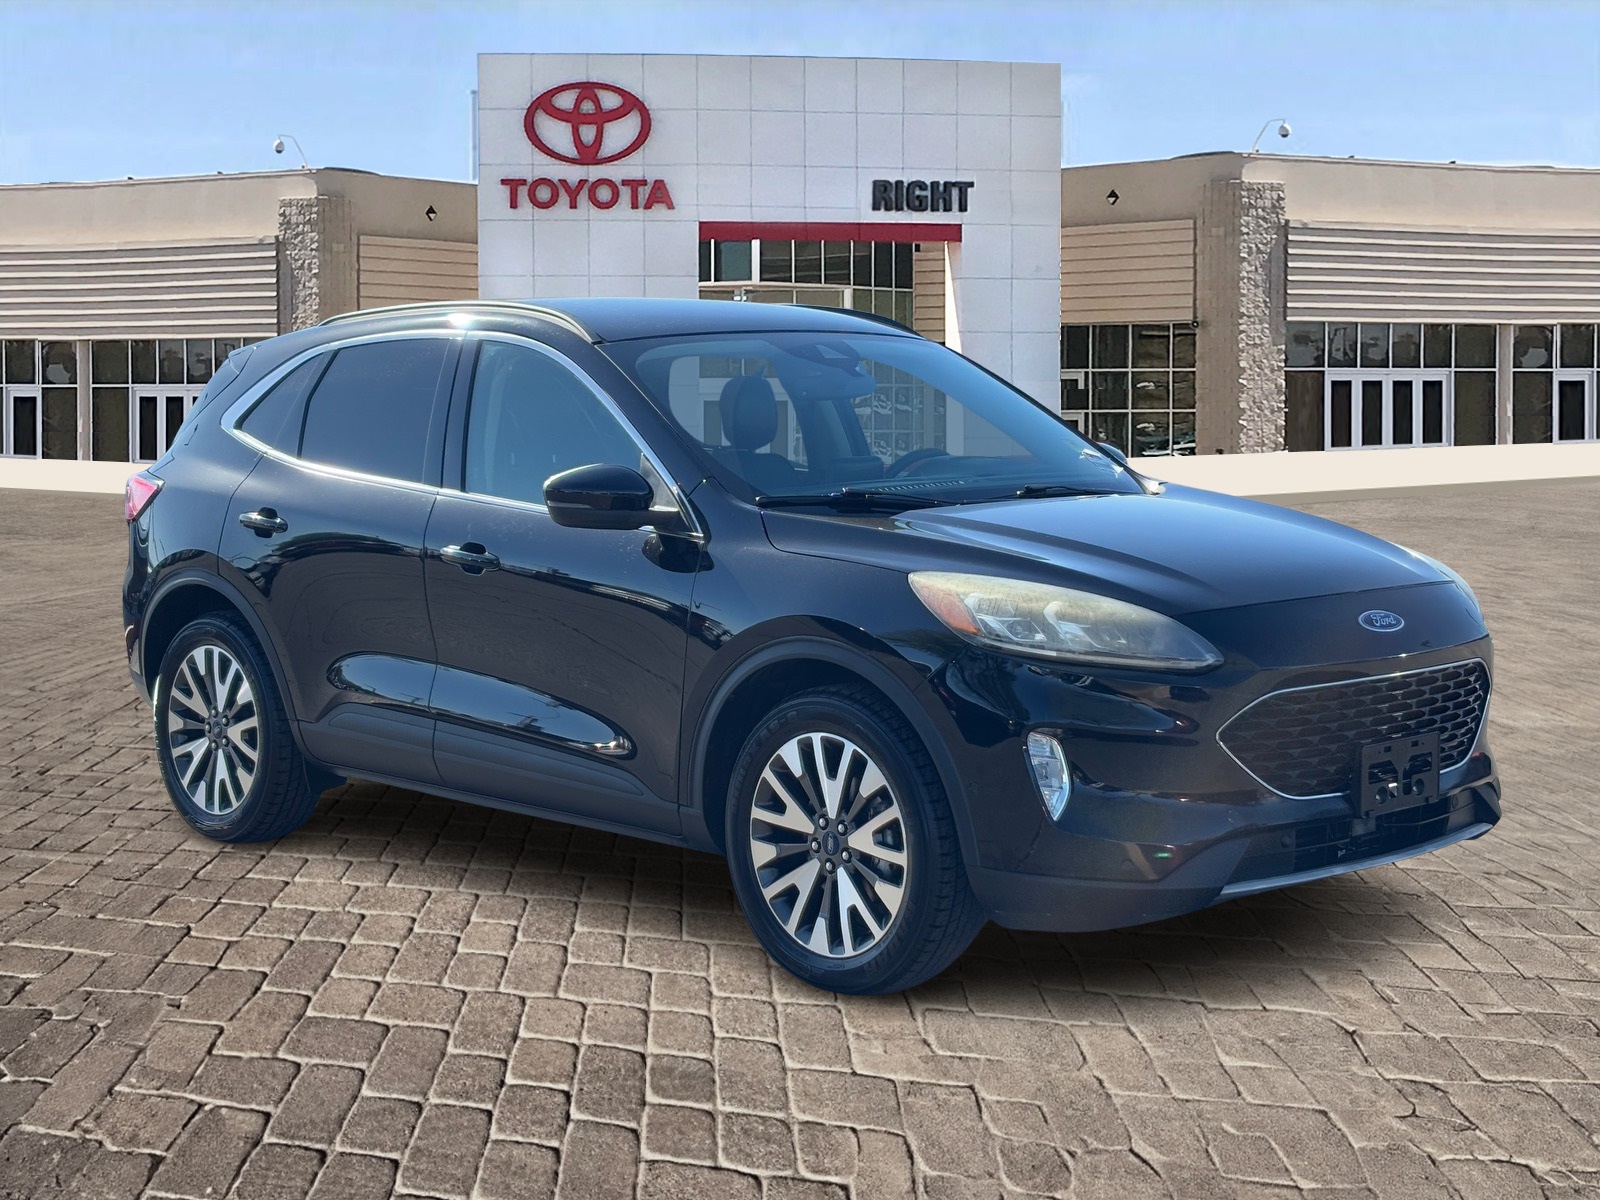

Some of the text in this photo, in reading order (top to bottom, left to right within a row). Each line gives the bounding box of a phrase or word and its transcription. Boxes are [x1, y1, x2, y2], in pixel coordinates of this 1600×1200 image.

[500, 178, 676, 210] TOYOTA
[871, 179, 975, 213] RIGHT
[1370, 613, 1396, 627] Ford
